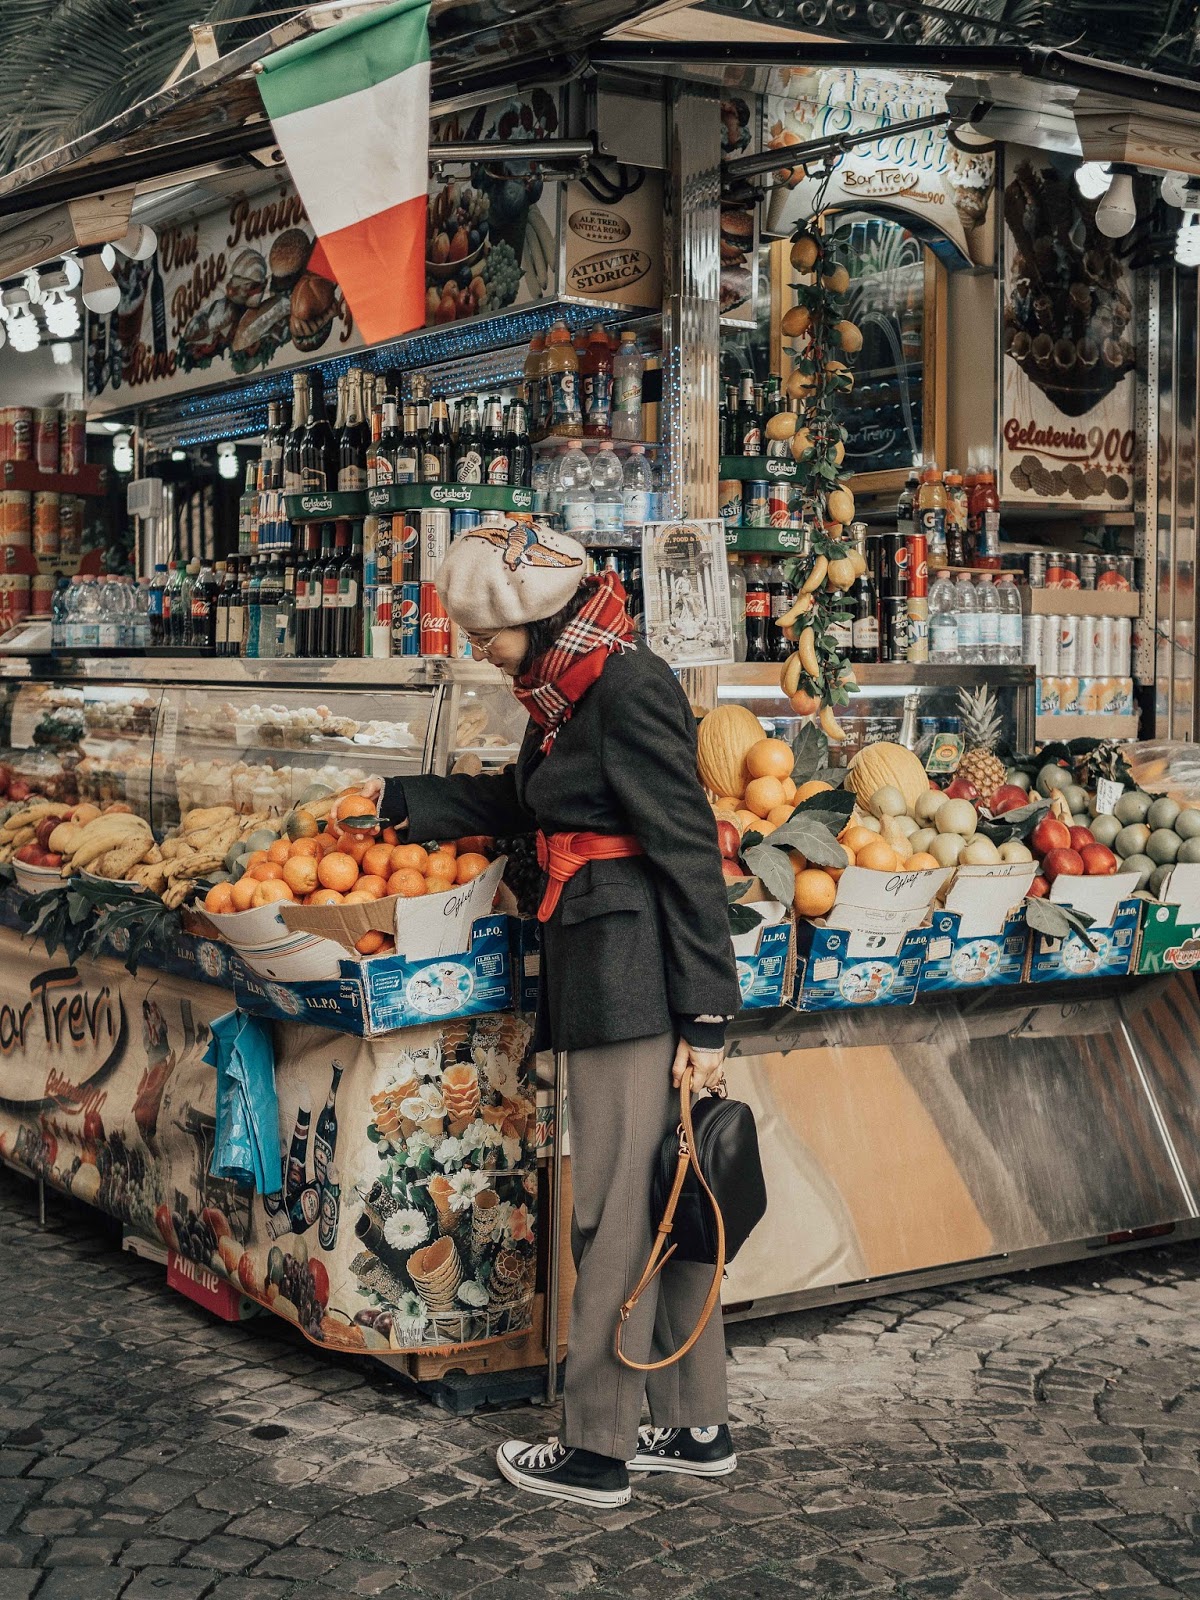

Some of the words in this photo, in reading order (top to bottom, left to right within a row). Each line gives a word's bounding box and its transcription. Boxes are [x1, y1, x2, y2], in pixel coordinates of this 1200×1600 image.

[842, 170, 875, 186] Bar
[875, 168, 914, 184] Trevi
[927, 190, 945, 204] 900
[226, 187, 309, 248] Panin
[574, 223, 602, 233] ANTICA
[603, 227, 626, 236] ROMA
[160, 225, 199, 273] Vini
[571, 251, 640, 279] ATTIVITA'
[577, 265, 642, 290] STORICA
[171, 252, 228, 337] Bibite
[1004, 418, 1087, 449] Gelateria
[1088, 426, 1136, 462] 900
[766, 460, 797, 477] Carlsberg
[368, 489, 390, 508] Carlsberg
[430, 486, 472, 504] Carlsberg
[301, 496, 333, 514] Carlsberg
[719, 506, 742, 518] NESTE
[426, 524, 437, 558] pepsi
[473, 926, 503, 939] I.L.P.O.
[763, 932, 787, 943] I.L.P.O.
[0, 1001, 32, 1056] ar
[30, 966, 115, 1050] Trevi
[306, 997, 341, 1010] I.L.P.O.
